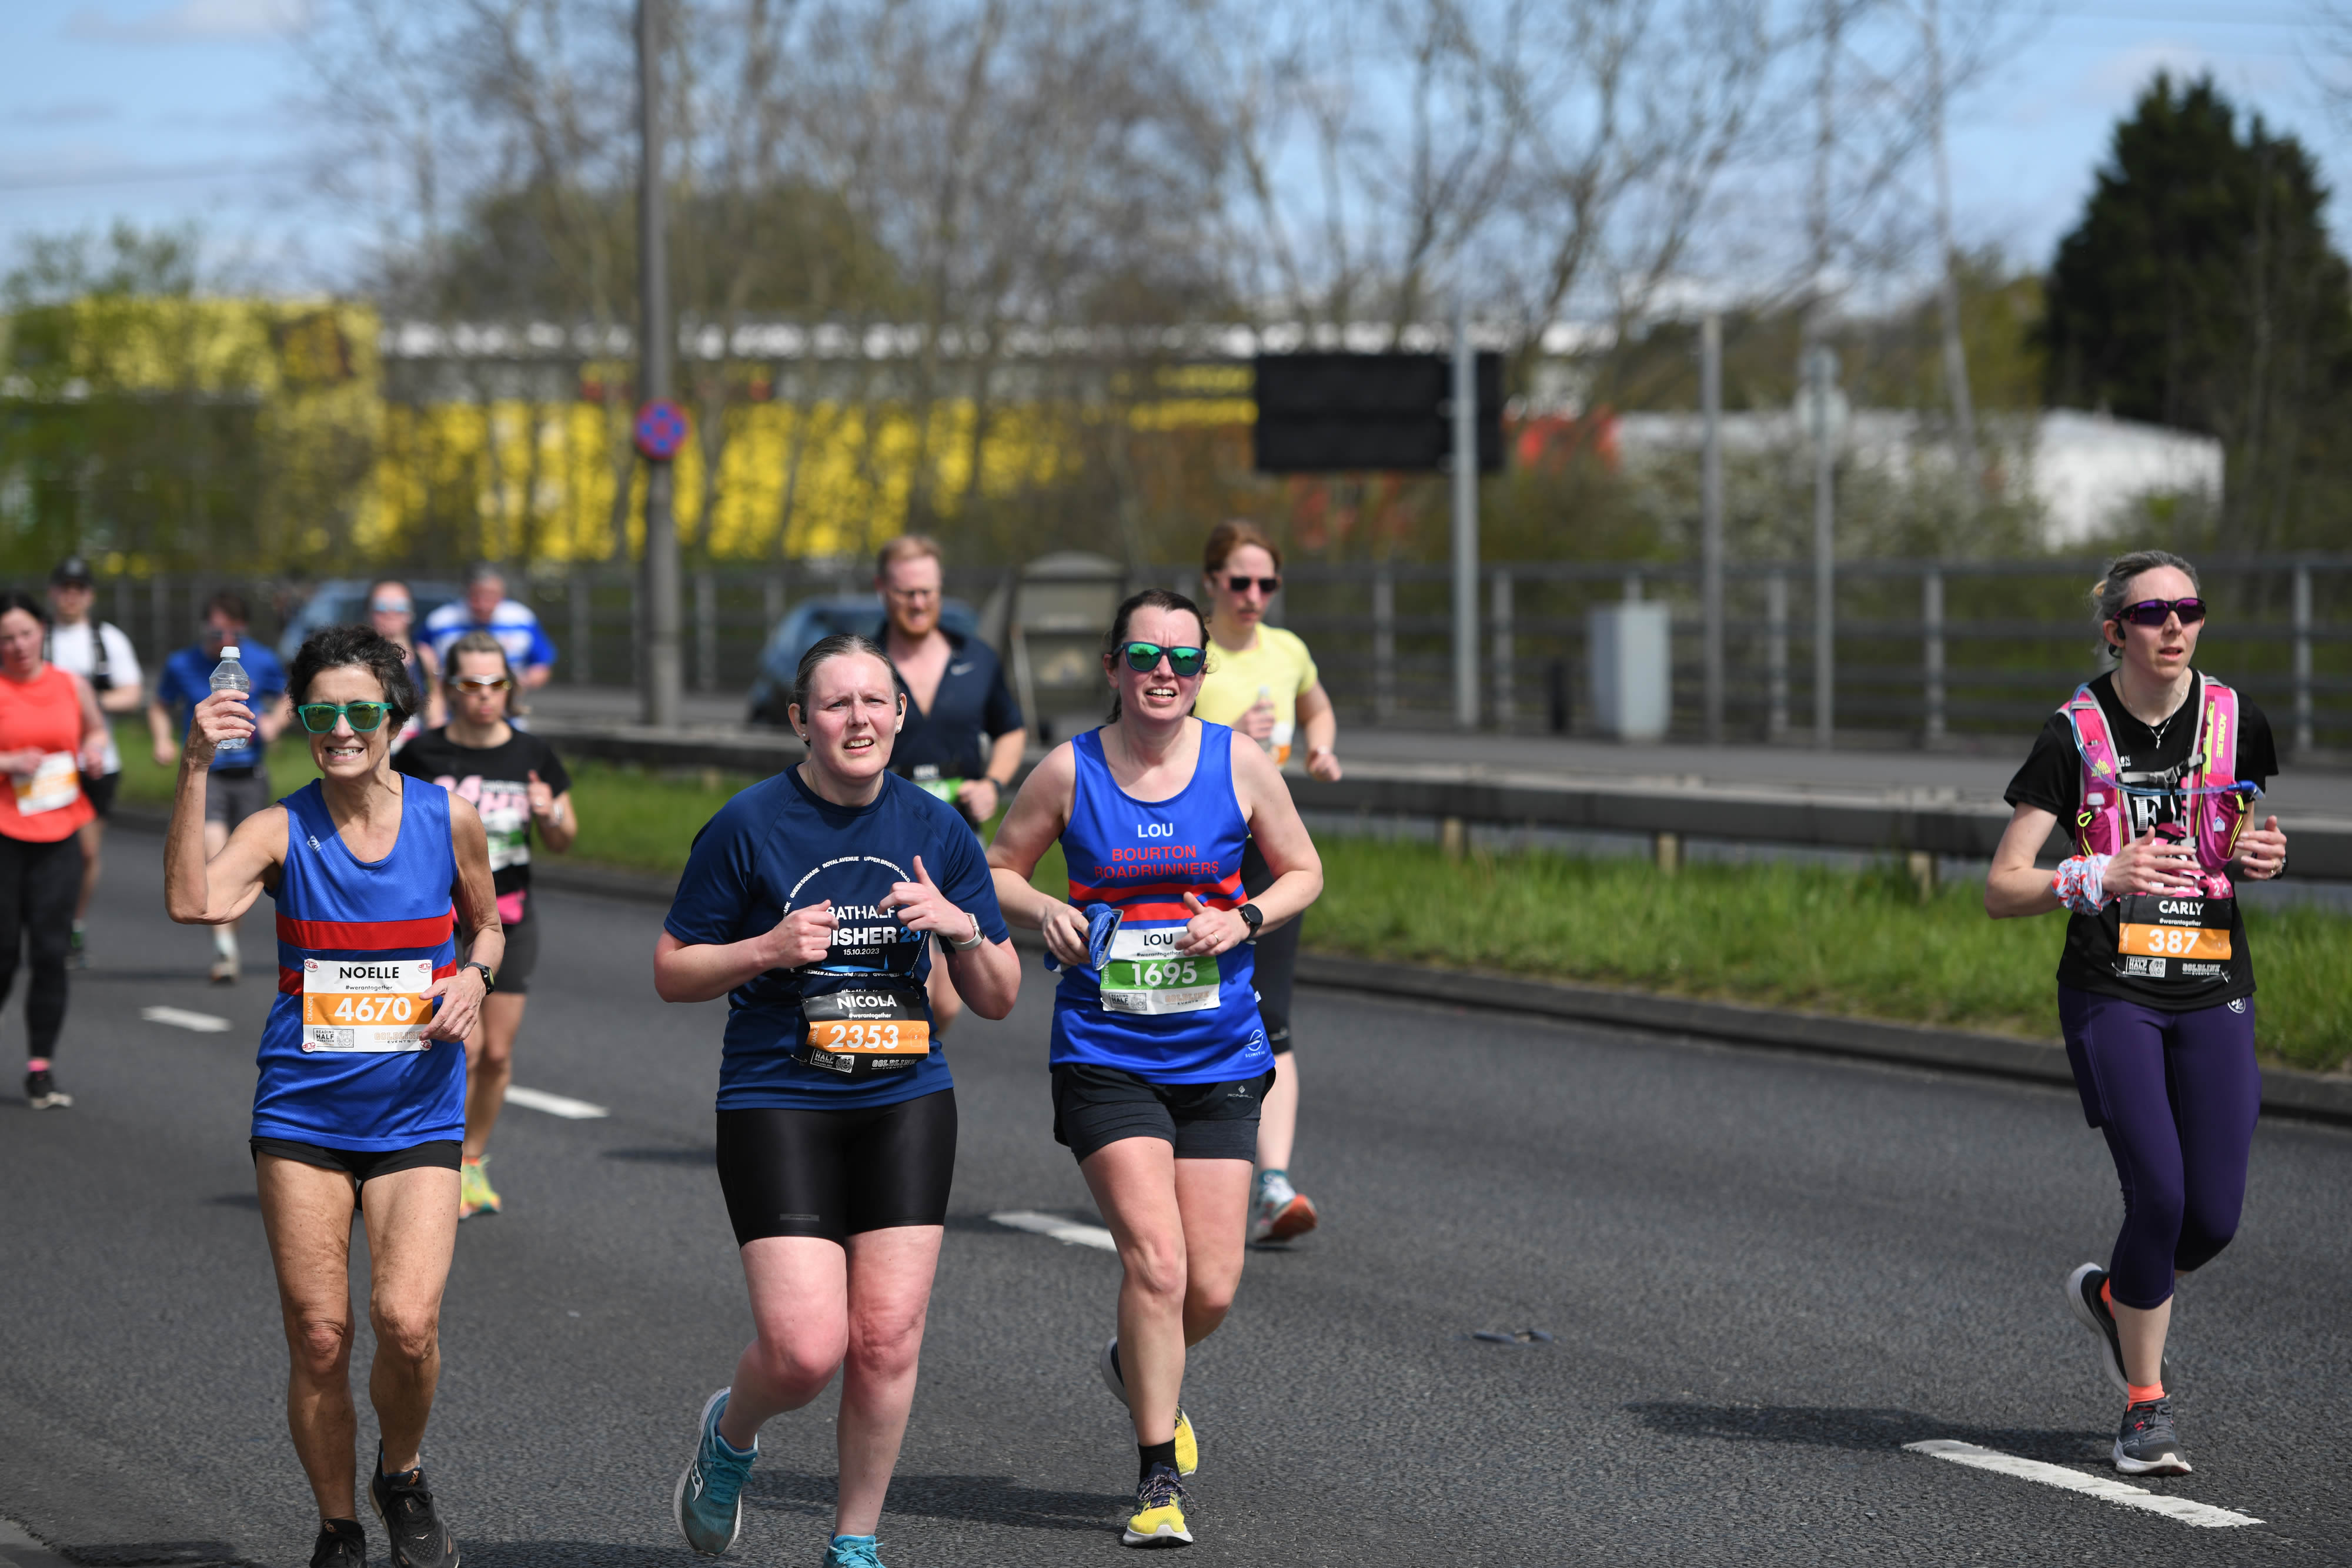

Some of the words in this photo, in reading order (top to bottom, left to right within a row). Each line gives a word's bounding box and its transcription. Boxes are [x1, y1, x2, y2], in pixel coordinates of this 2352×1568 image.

[1138, 823, 1174, 838] LOU
[1112, 845, 1197, 861] BOURTON
[822, 859, 839, 869] ROYAL
[880, 859, 900, 872] BRISTOL
[900, 870, 911, 882] ROAD
[1094, 861, 1219, 880] ROADRUNNERS
[790, 882, 802, 898] QUEEN
[800, 867, 820, 884] SQUARE
[2159, 900, 2204, 915] CARLY
[2159, 918, 2202, 927] #werantogether
[828, 927, 897, 945] ISHER
[1144, 933, 1173, 946] LOU
[2148, 928, 2201, 954] 387
[339, 967, 399, 979] NOELLE
[1131, 961, 1197, 987] 1695
[334, 997, 412, 1021] 4670
[837, 995, 897, 1009] NICOLA
[827, 1025, 899, 1049] 2353
[816, 1053, 834, 1061] HALF
